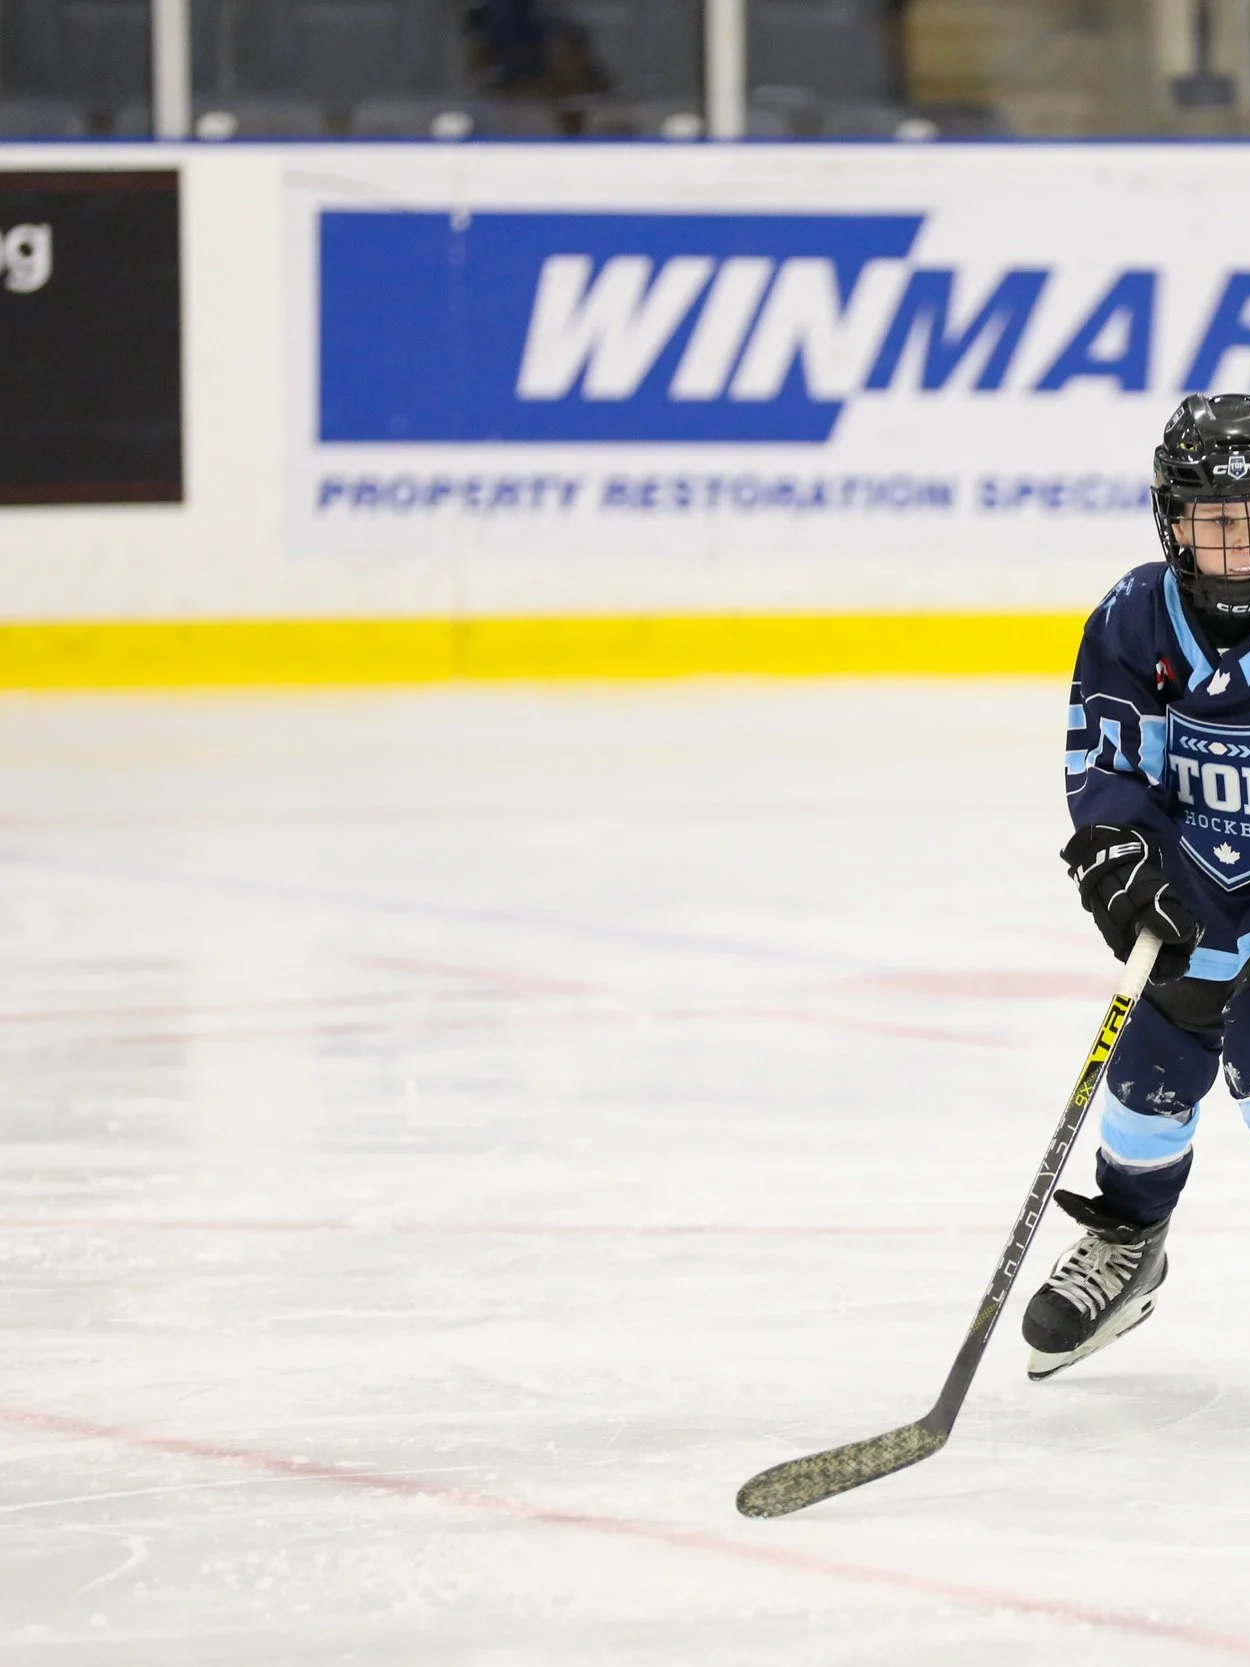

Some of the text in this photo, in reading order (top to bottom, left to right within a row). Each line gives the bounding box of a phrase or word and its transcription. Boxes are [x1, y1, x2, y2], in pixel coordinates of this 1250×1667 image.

[0, 222, 53, 294] g
[316, 474, 580, 514] PROPERTY
[602, 474, 954, 514] RESTORATION
